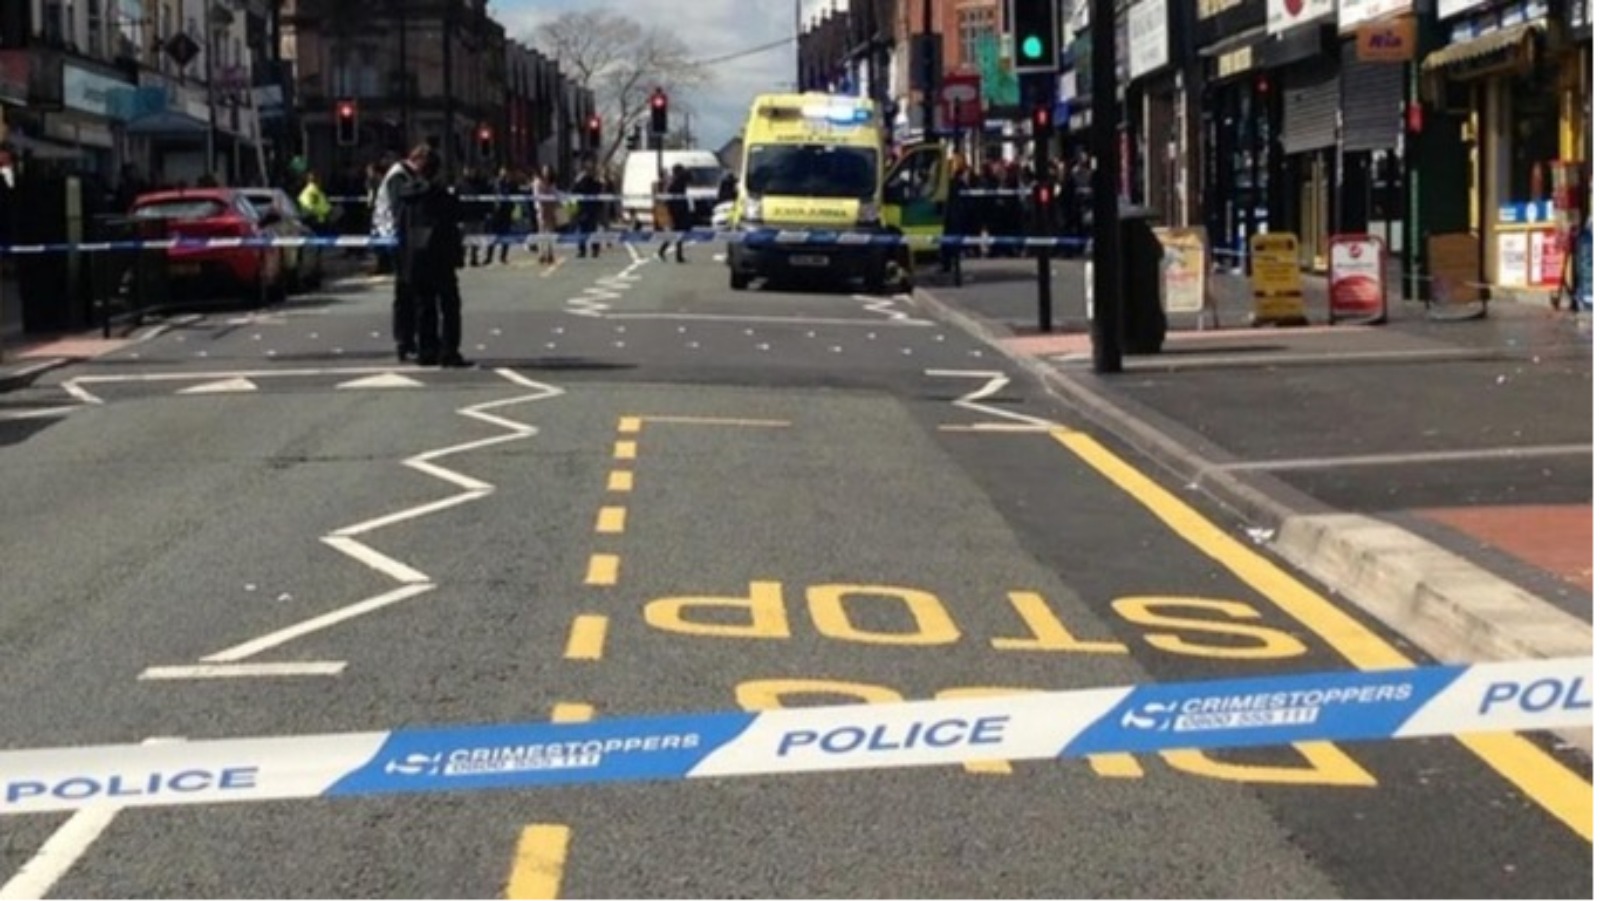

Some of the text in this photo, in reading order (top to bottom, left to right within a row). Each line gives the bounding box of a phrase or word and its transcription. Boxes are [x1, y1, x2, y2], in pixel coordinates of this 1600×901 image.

[644, 580, 1308, 660] STOP
[1181, 682, 1413, 716] CRIMESTOPPERS
[1478, 676, 1594, 715] POL
[449, 732, 700, 764] CRIMESTOPPERS
[776, 714, 1011, 757] POLICE
[6, 766, 259, 803] POLICE
